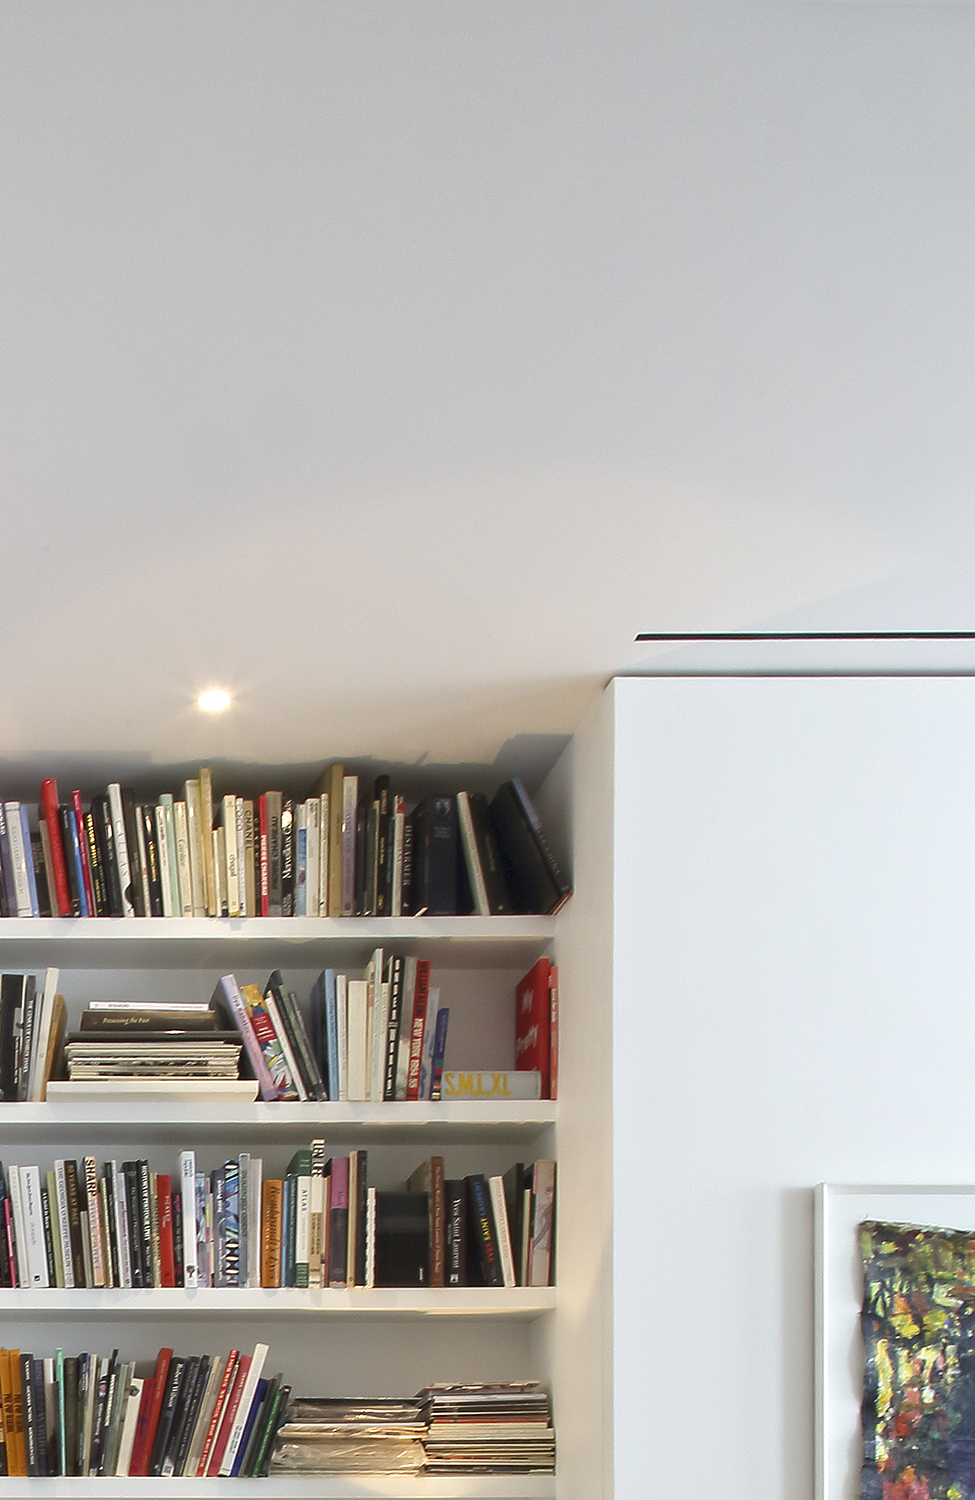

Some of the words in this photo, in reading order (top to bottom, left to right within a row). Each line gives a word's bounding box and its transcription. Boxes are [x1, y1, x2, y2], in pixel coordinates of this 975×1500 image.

[245, 809, 253, 851] CHANEL
[413, 1018, 423, 1036] NEW
[411, 1038, 422, 1057] YORK
[85, 1159, 97, 1197] SHARP
[453, 1198, 461, 1215] Yves
[453, 1218, 462, 1237] Saint
[480, 1218, 491, 1241] SAINT
[452, 1239, 461, 1268] Laurent
